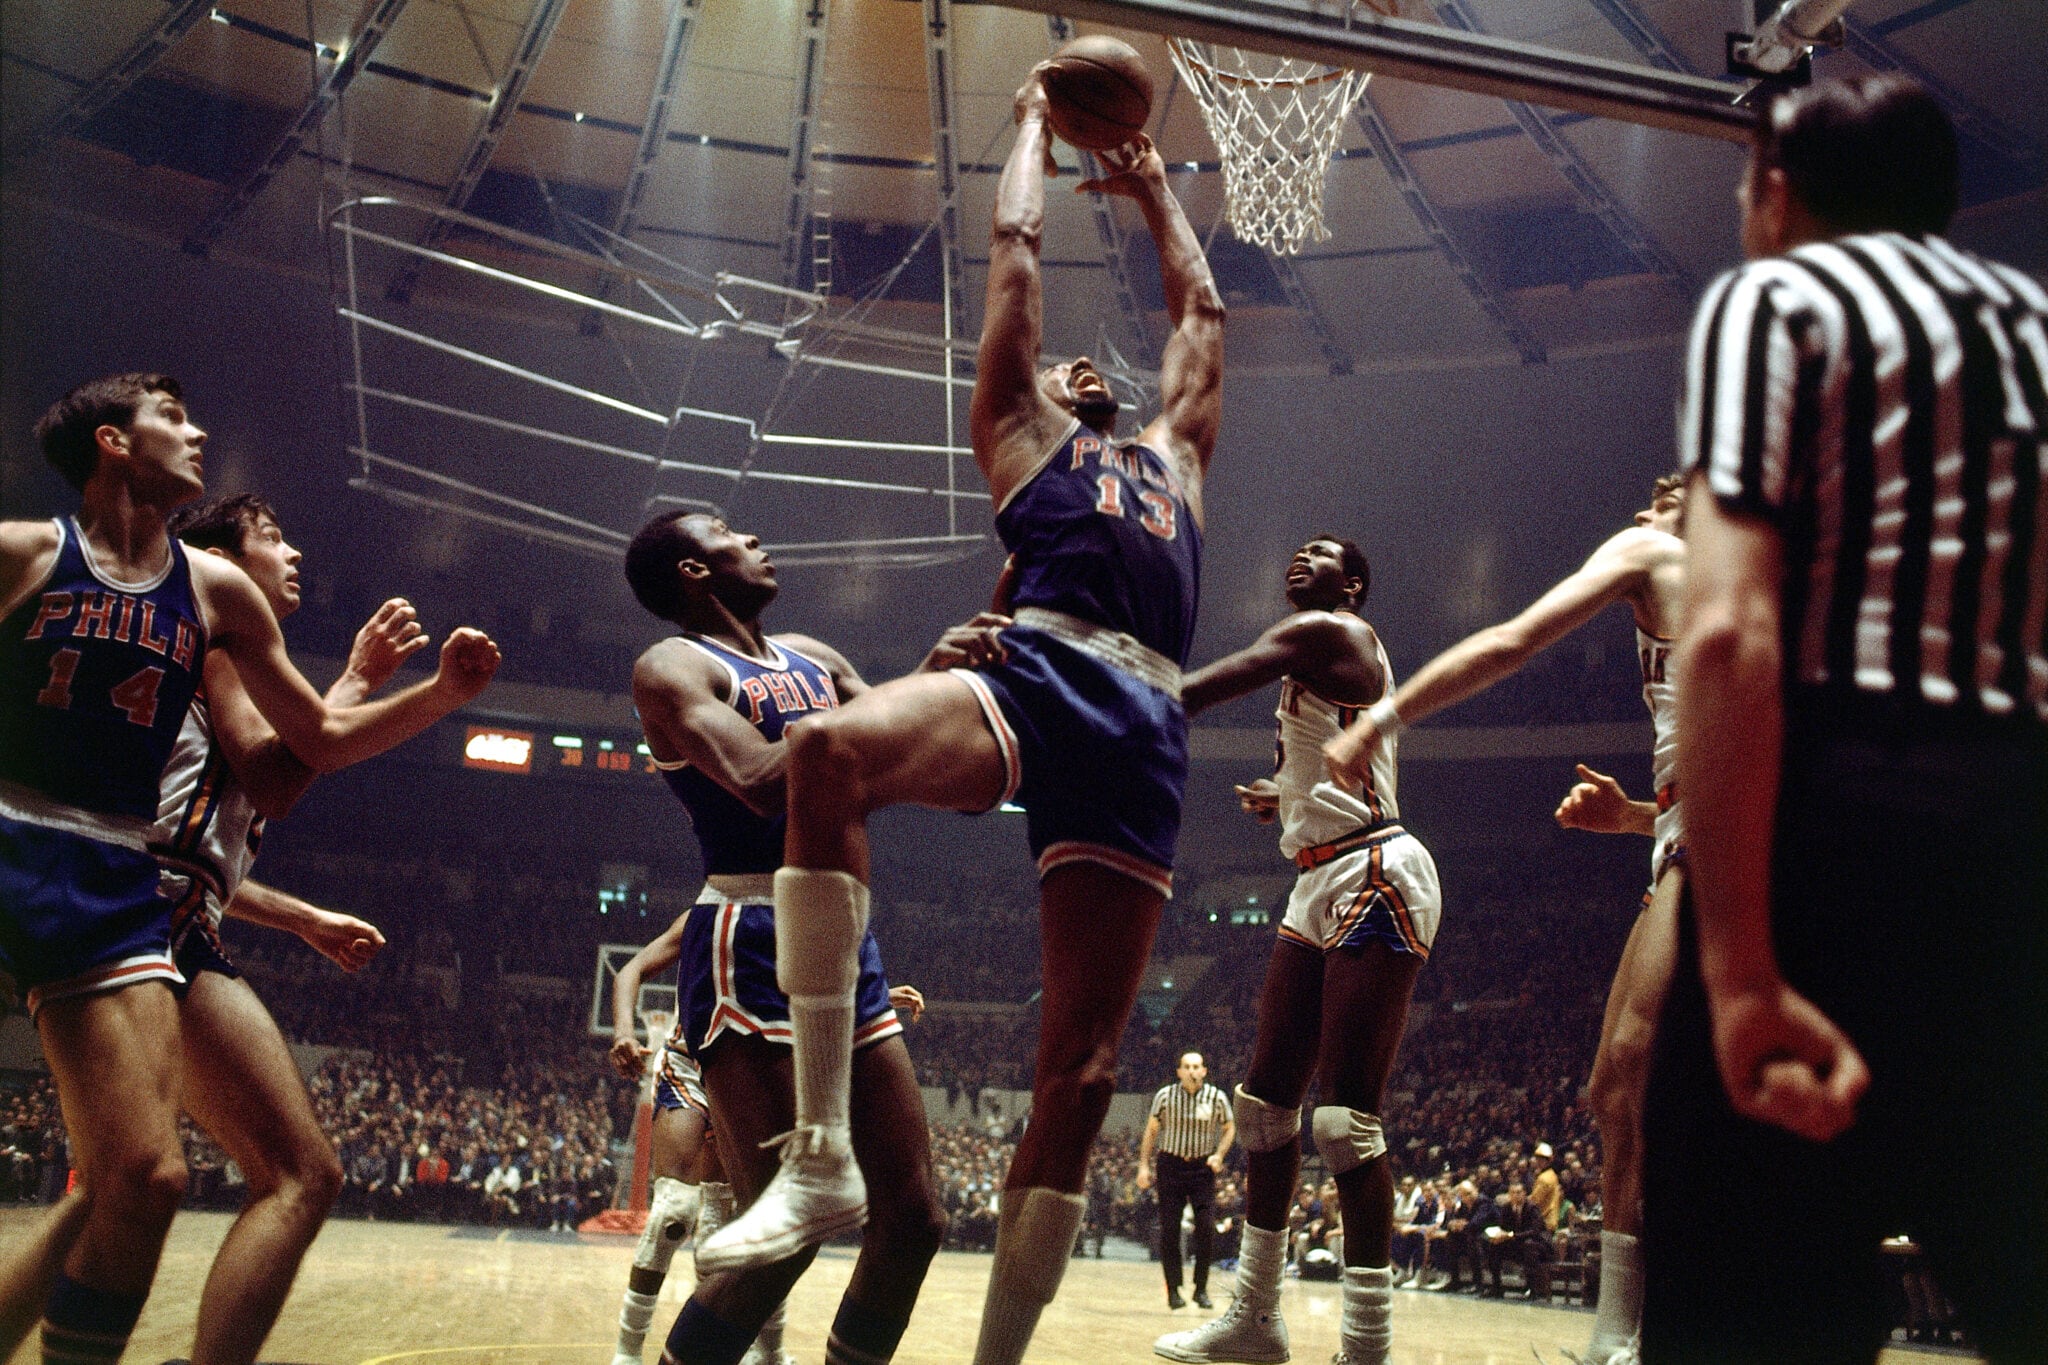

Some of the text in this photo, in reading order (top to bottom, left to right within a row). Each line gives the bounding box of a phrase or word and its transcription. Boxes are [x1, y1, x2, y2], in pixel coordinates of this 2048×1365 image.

[1096, 473, 1177, 541] 13
[24, 591, 199, 672] PHILA
[37, 647, 166, 727] 14
